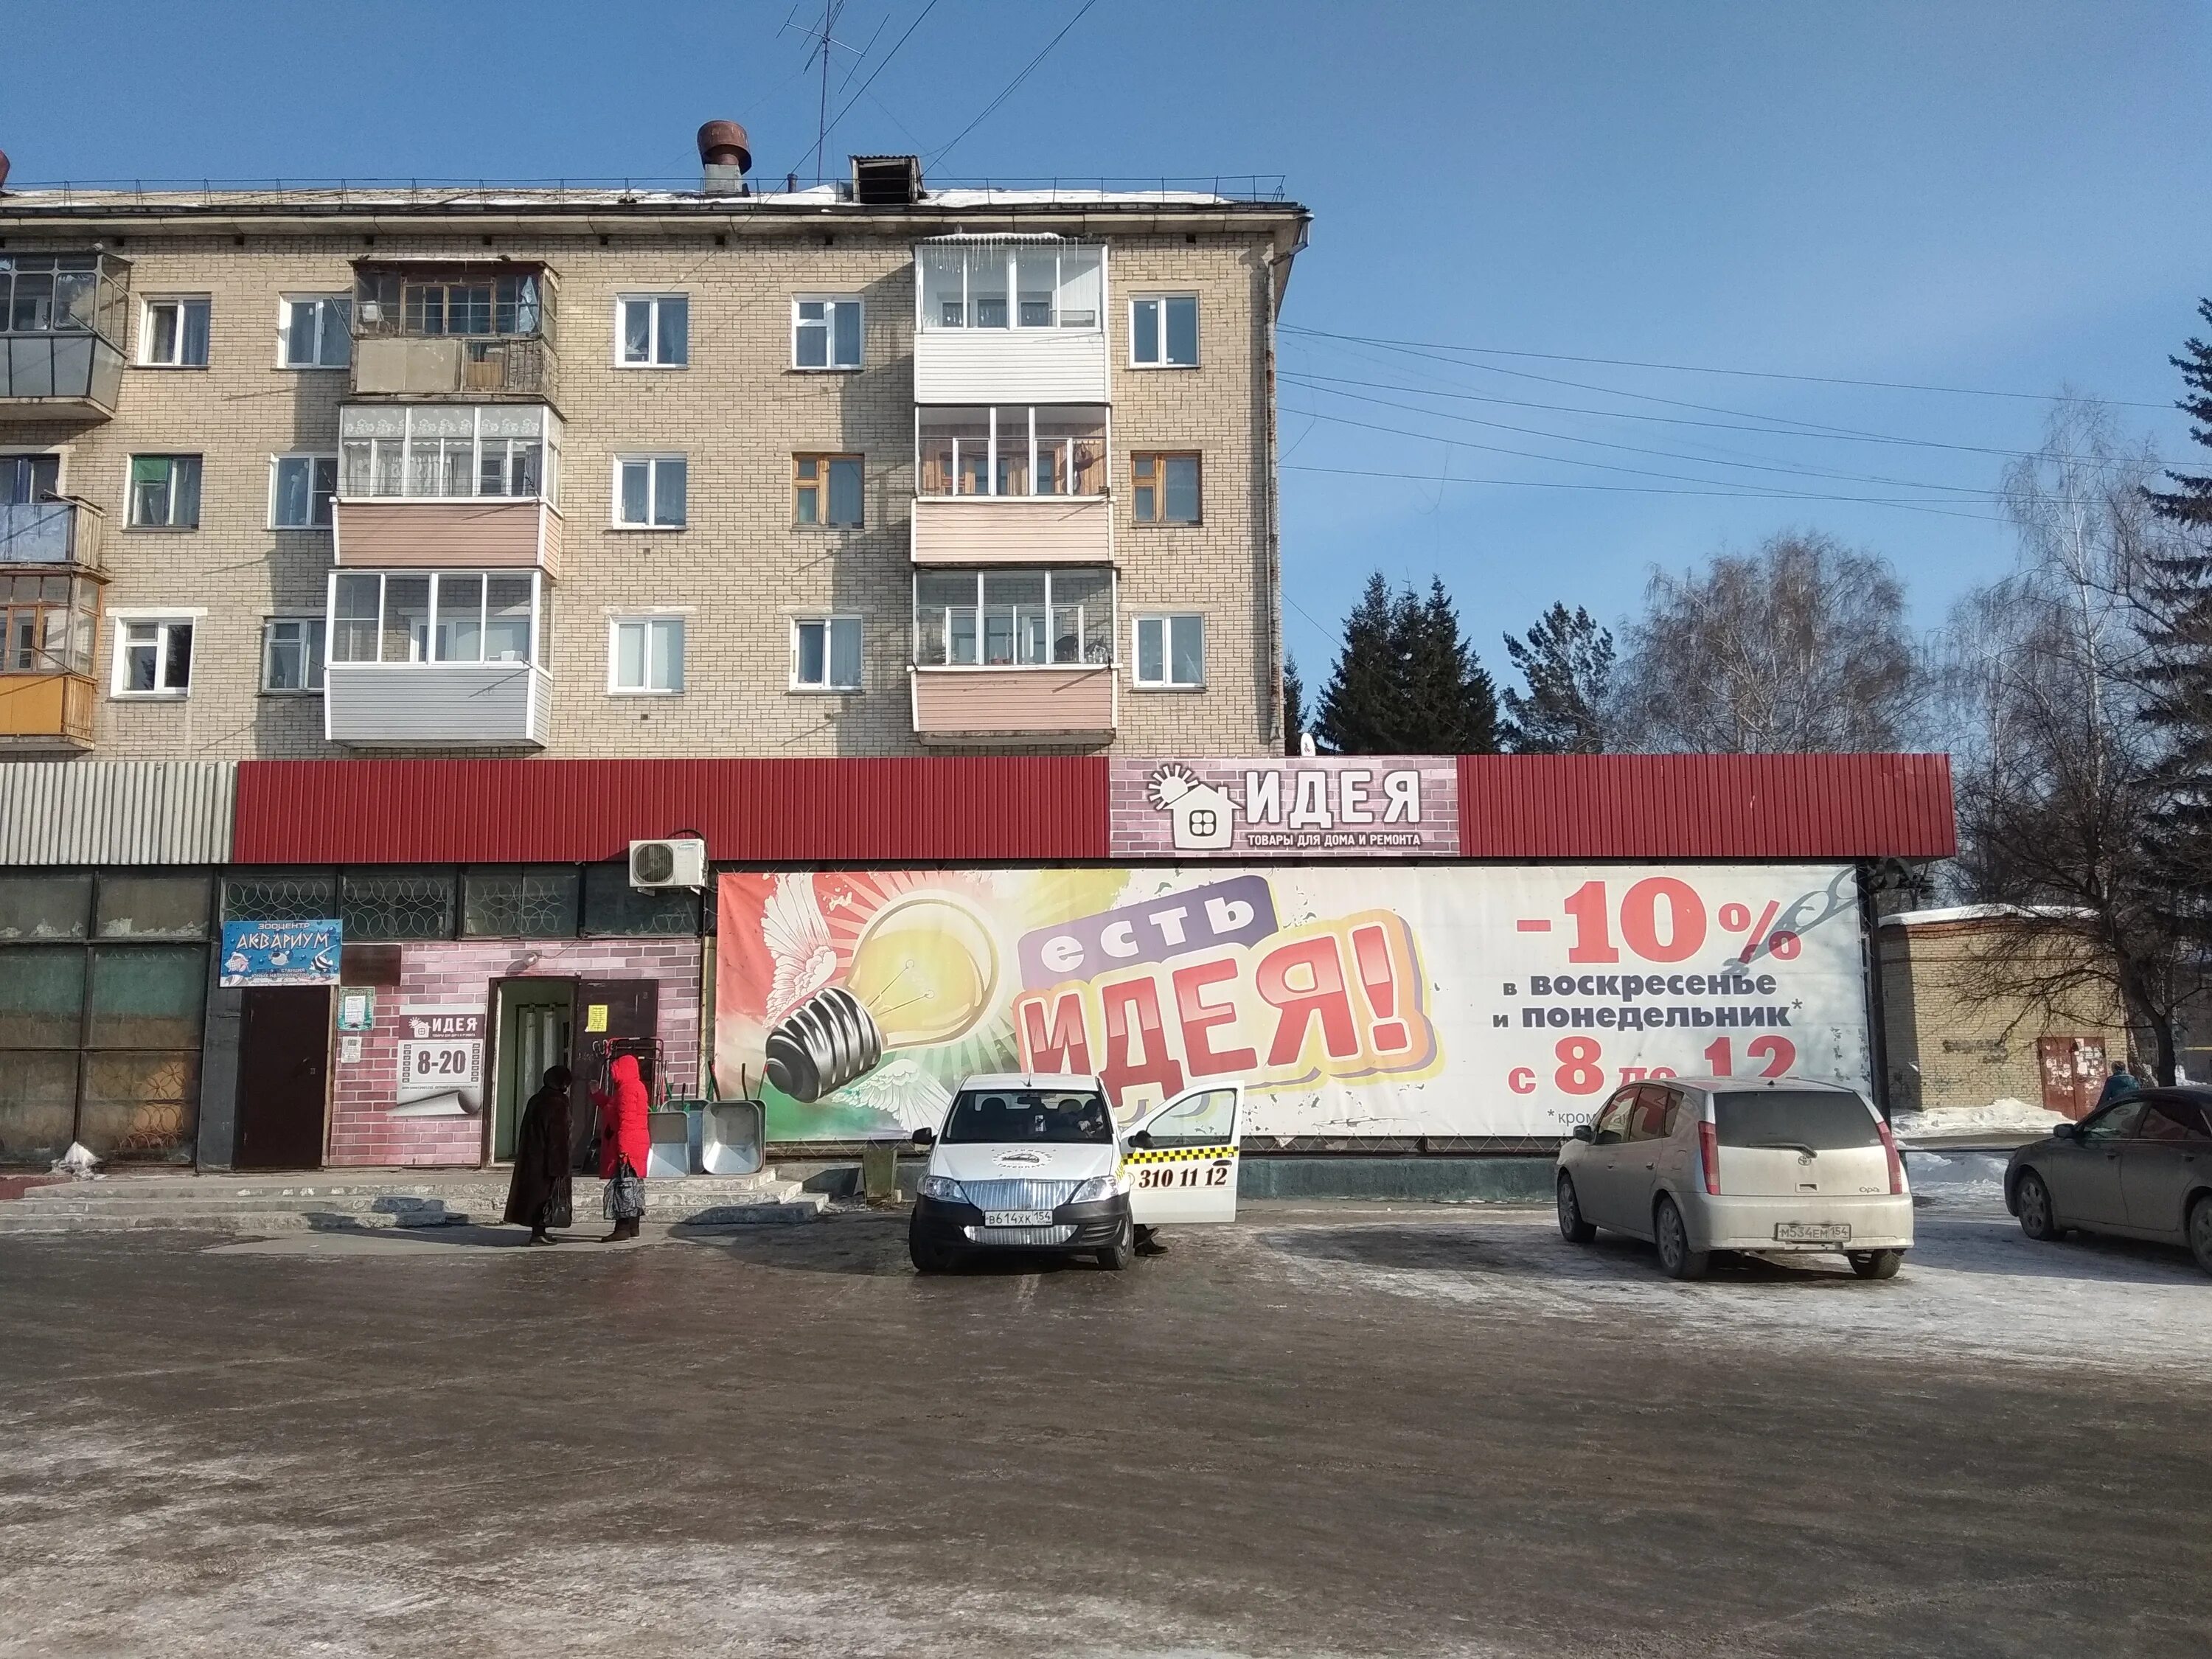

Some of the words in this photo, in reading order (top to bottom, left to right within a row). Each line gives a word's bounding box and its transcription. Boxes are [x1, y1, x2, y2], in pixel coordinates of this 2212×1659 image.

[1246, 770, 1420, 829] ИДЕЯ
[1248, 835, 1293, 846] ТОВАРЫ
[1298, 835, 1321, 846] ДЛЯ
[1324, 835, 1354, 846] ДОМА
[1359, 835, 1366, 845] И
[1370, 834, 1421, 845] РЕМОНТА
[1517, 876, 1802, 964] -10%
[236, 932, 330, 950] АКВАРИУМ
[1040, 895, 1255, 973] есть
[1503, 981, 1517, 995] в
[1530, 974, 1777, 1002] воскресенье
[433, 1018, 477, 1033] ИДЕЯ
[1023, 924, 1410, 1108] ИДЕЯ!
[1493, 1014, 1509, 1028] и
[417, 1050, 466, 1074] 8-20
[1508, 1066, 1537, 1094] с
[1554, 1035, 1604, 1095] 8
[1138, 1169, 1173, 1188] 310
[1180, 1168, 1198, 1186] 11
[1205, 1167, 1228, 1186] 12
[1034, 1211, 1050, 1220] 154
[1830, 1227, 1848, 1236] 154
